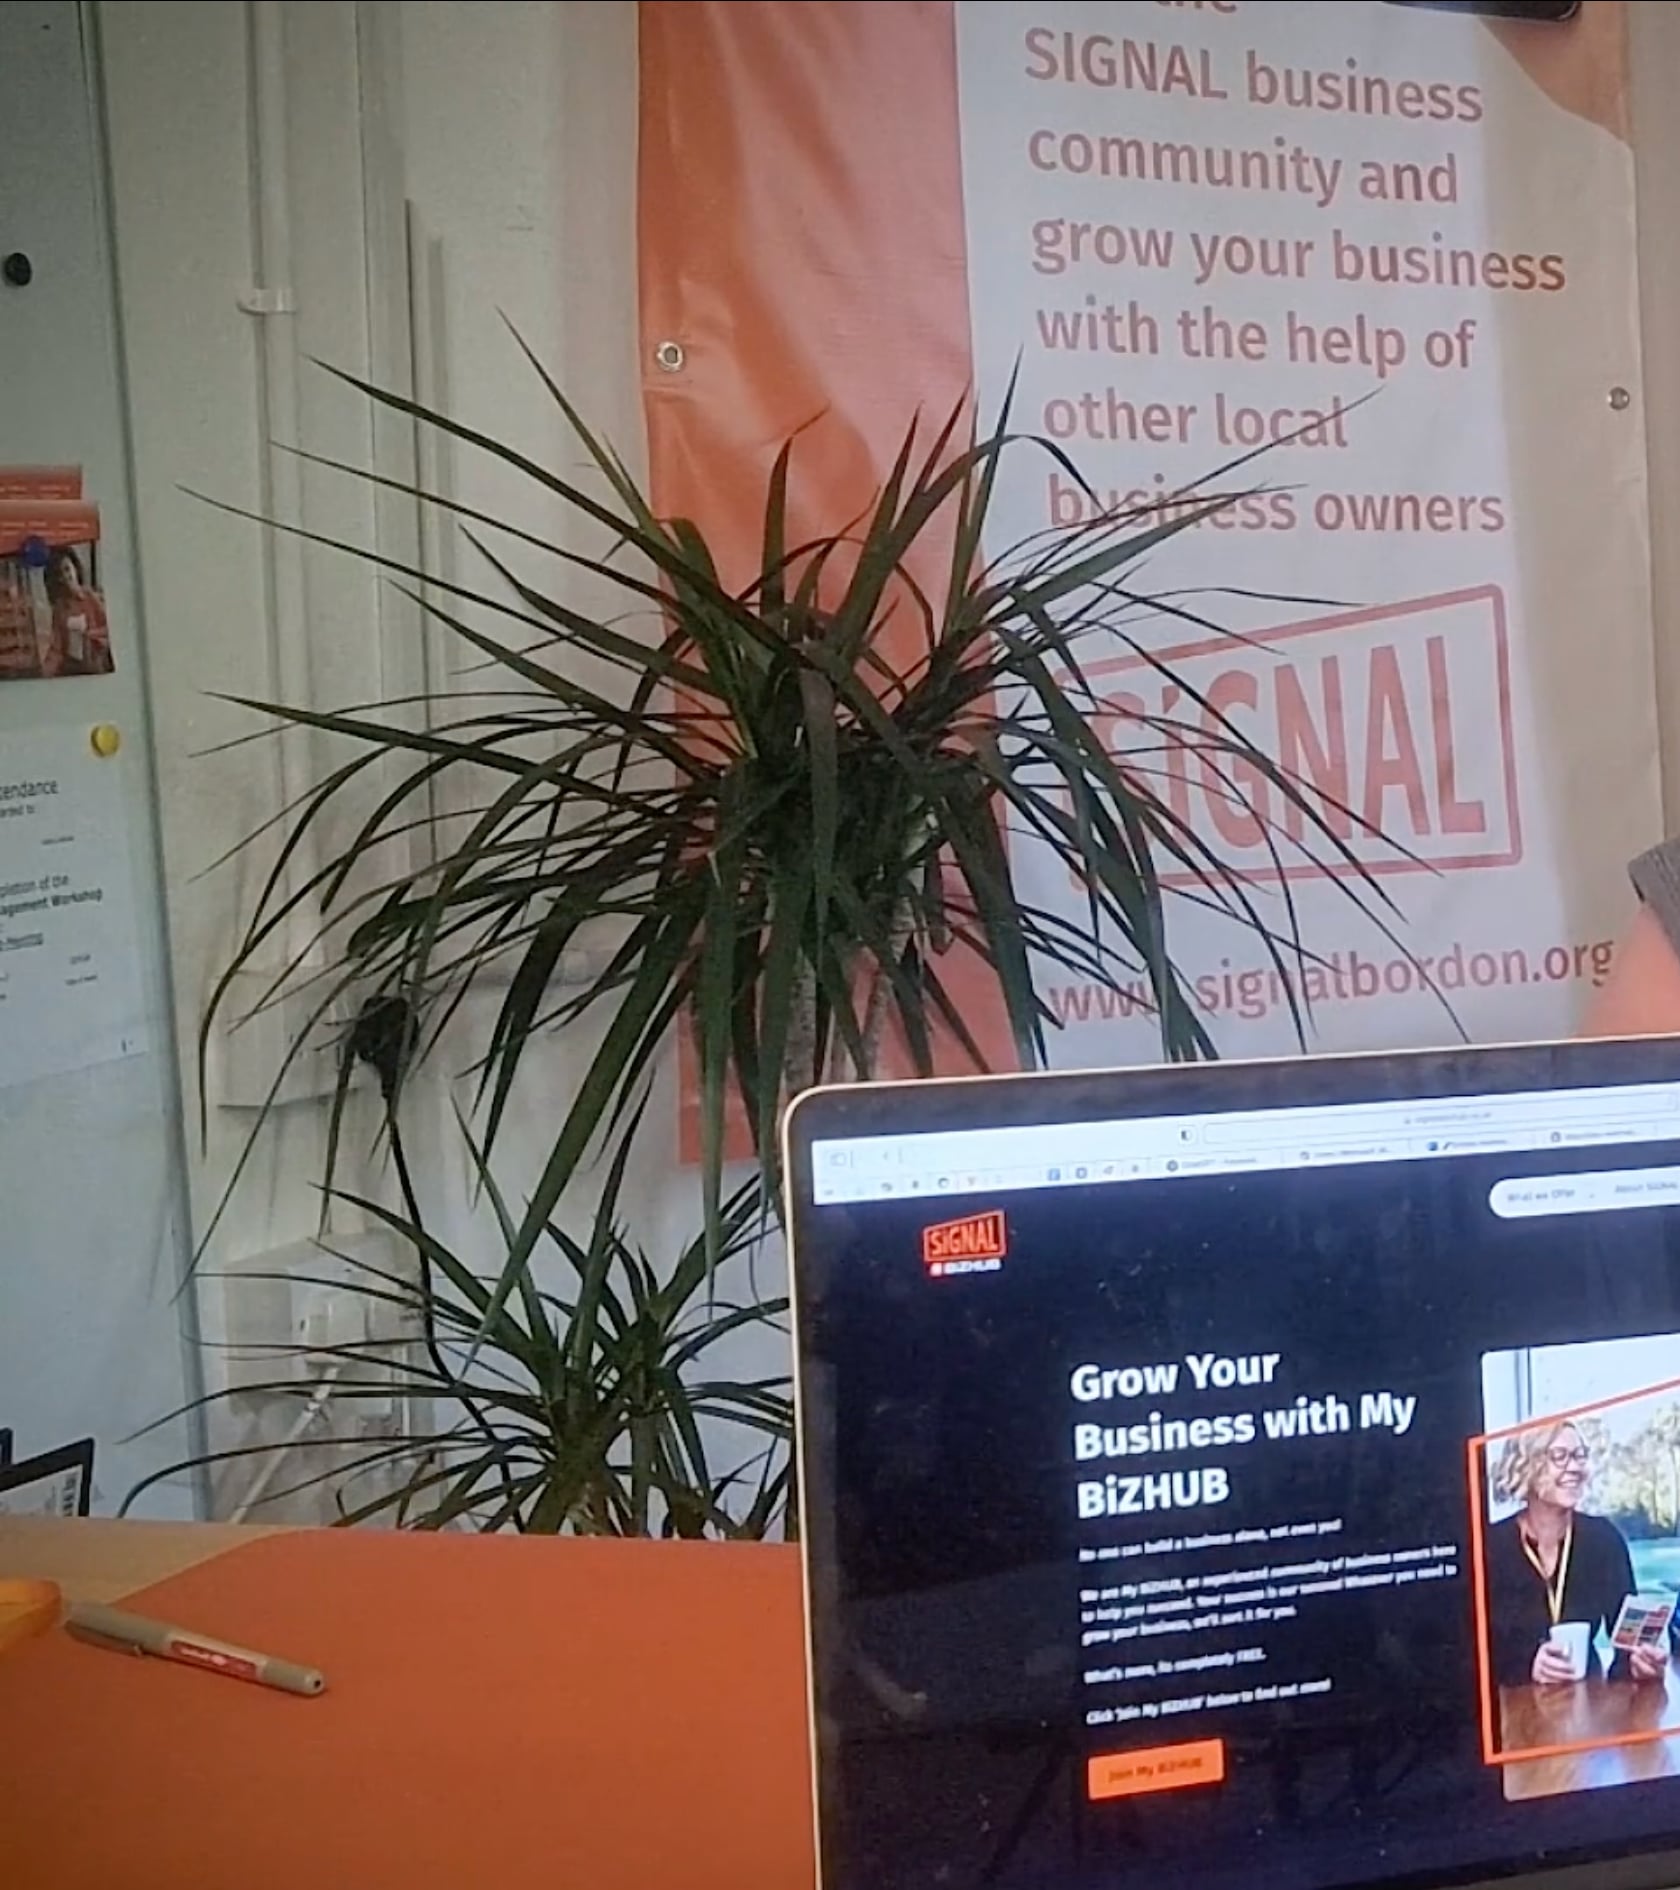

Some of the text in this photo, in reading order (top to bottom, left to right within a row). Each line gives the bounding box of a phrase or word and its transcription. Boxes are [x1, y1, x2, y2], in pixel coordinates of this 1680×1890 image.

[1024, 26, 1483, 122] SIGNAL business
[1029, 129, 1459, 207] community and
[1032, 217, 1566, 290] grow your business
[1037, 295, 1477, 378] with the help of
[1043, 387, 1348, 448] other local
[1048, 472, 1505, 532] business owners
[1049, 941, 1614, 1021] wwsignalbordon.org
[1070, 1352, 1281, 1401] Grow Your
[1074, 1392, 1416, 1461] Business with My
[1078, 1468, 1230, 1518] BiZHUB
